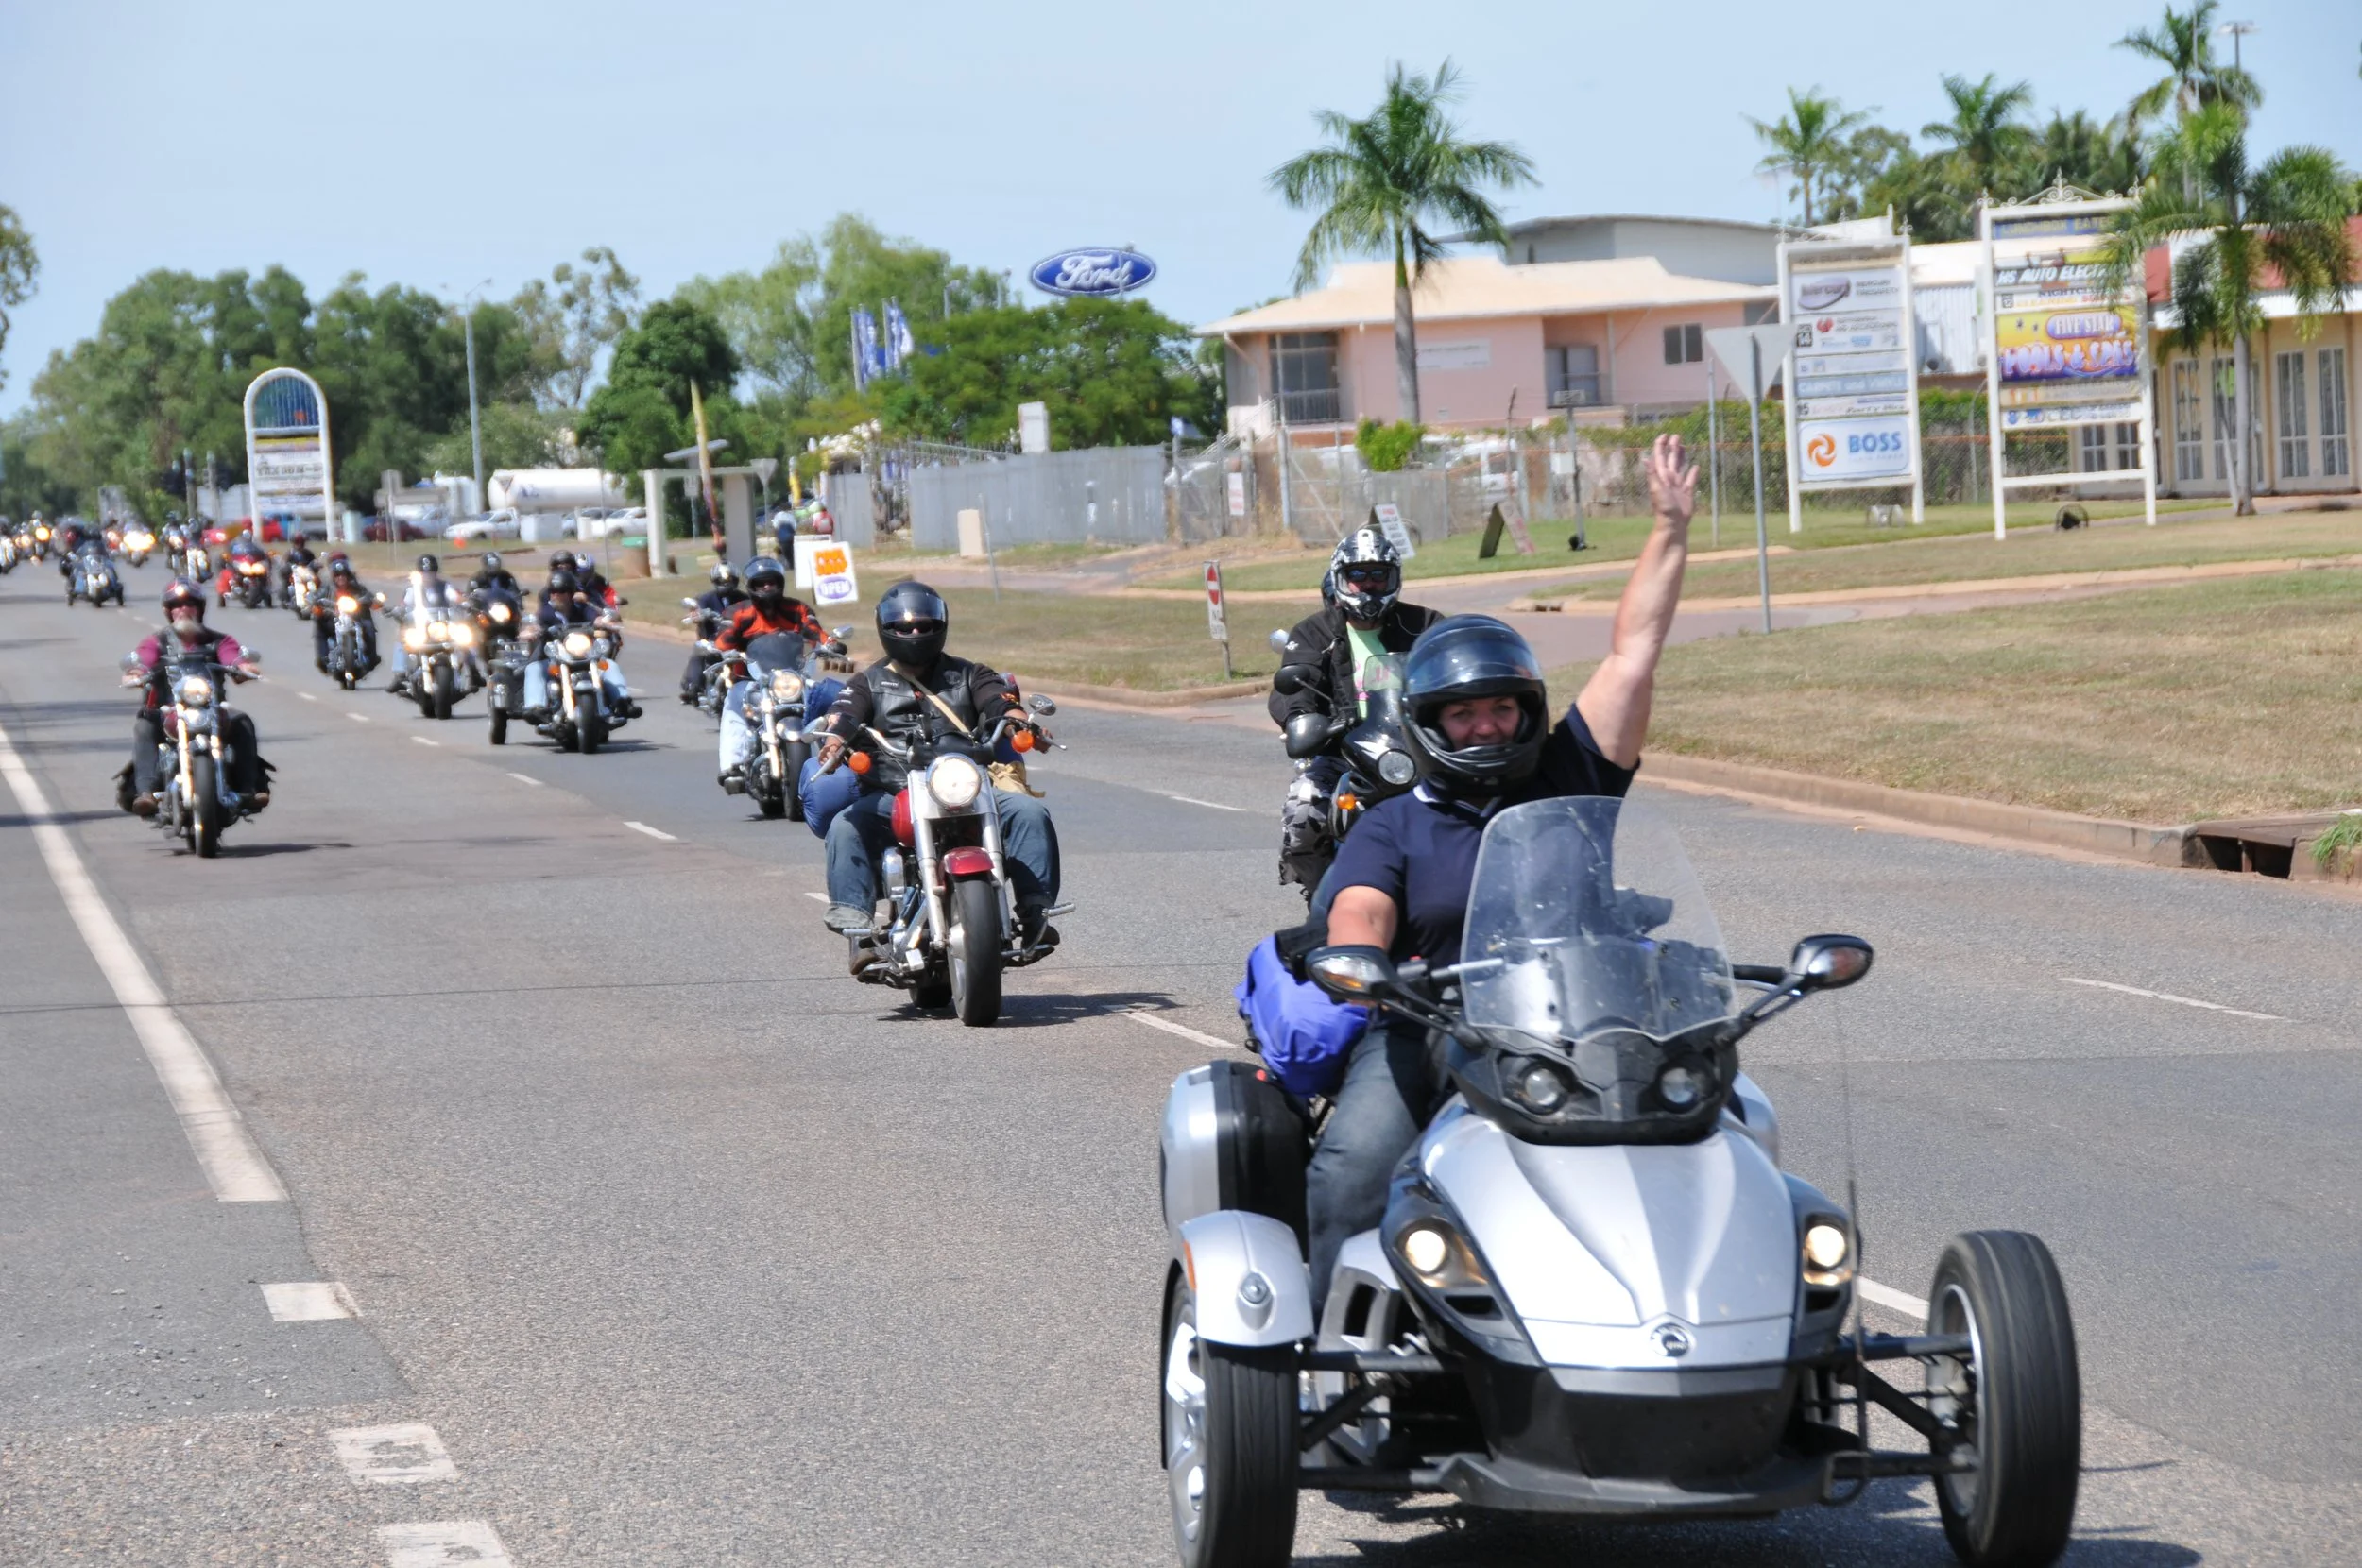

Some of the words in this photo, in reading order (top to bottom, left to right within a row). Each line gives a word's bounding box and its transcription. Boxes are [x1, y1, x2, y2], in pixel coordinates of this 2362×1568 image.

[1055, 254, 1133, 289] Ford
[2019, 265, 2058, 283] AUTO
[2055, 315, 2080, 335] FIVE
[2084, 313, 2115, 332] STAR
[2003, 342, 2065, 376] POOLS
[2089, 339, 2135, 369] SPAS
[1848, 430, 1902, 453] BOSS
[820, 580, 850, 596] OPEN
